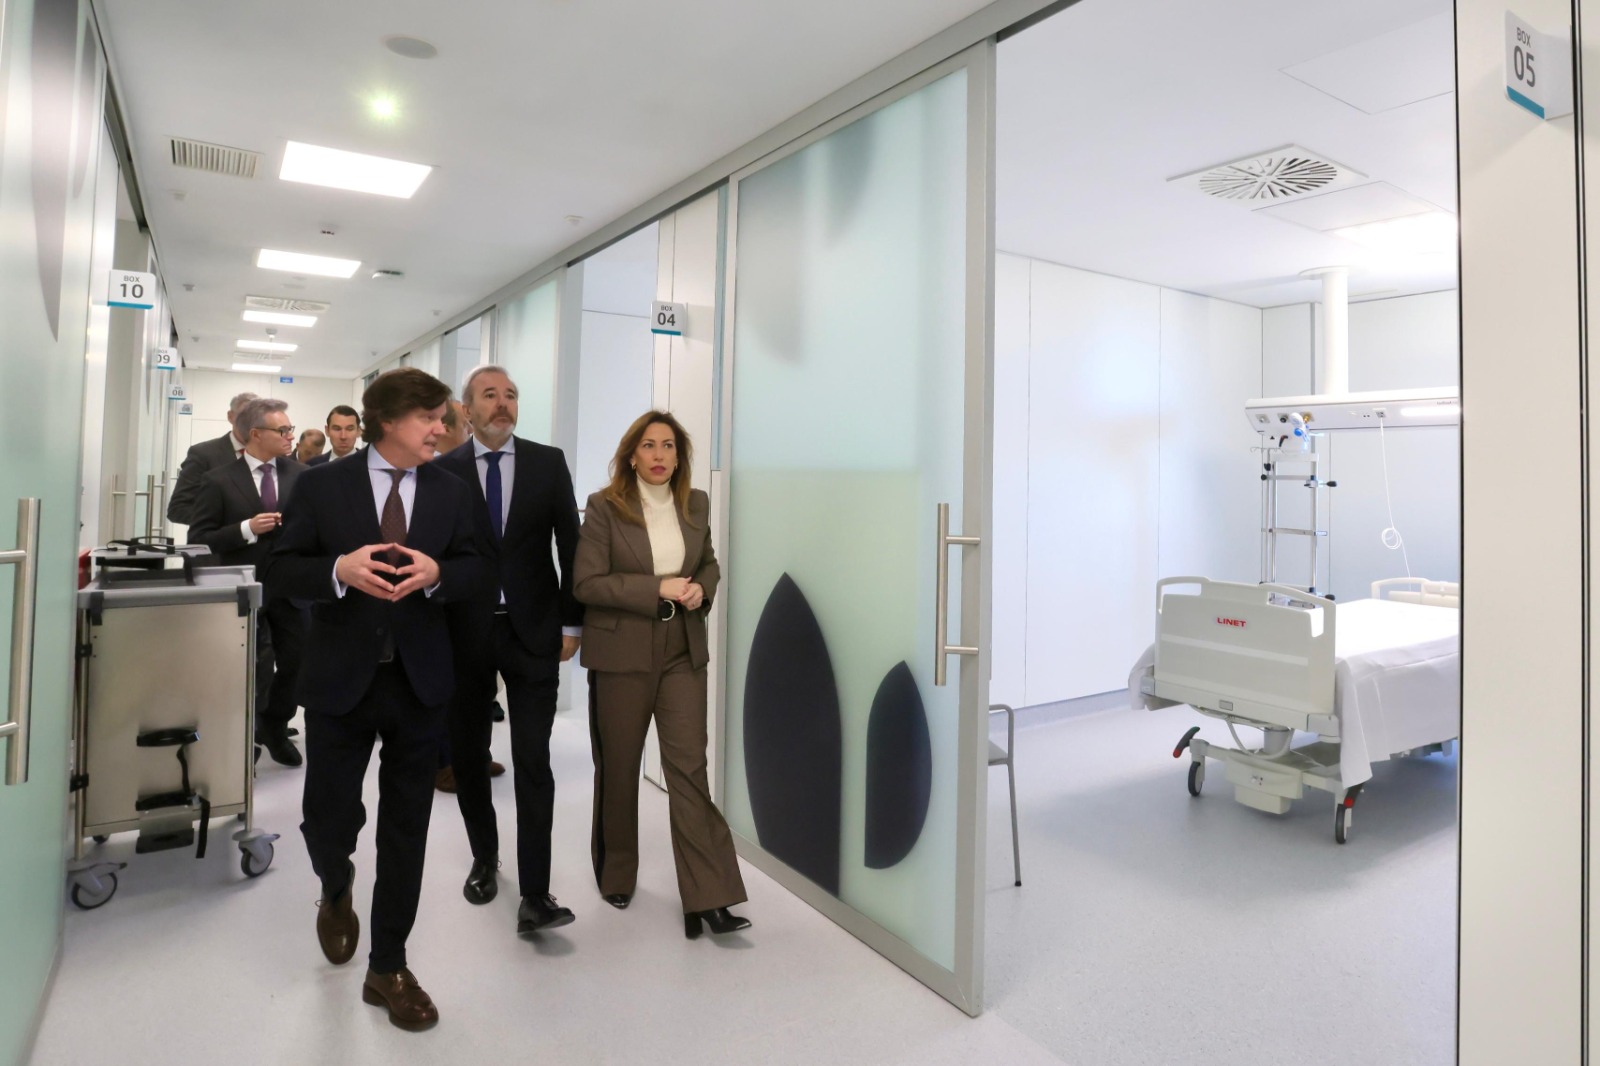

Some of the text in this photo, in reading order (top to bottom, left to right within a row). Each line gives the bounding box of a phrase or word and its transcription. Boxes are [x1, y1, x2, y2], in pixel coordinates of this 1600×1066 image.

[1516, 26, 1531, 48] BOX
[1513, 45, 1536, 88] 05
[123, 274, 140, 283] BOX
[120, 283, 144, 299] 10
[657, 312, 676, 327] 04
[172, 389, 184, 397] 08
[1216, 617, 1247, 628] LINET
